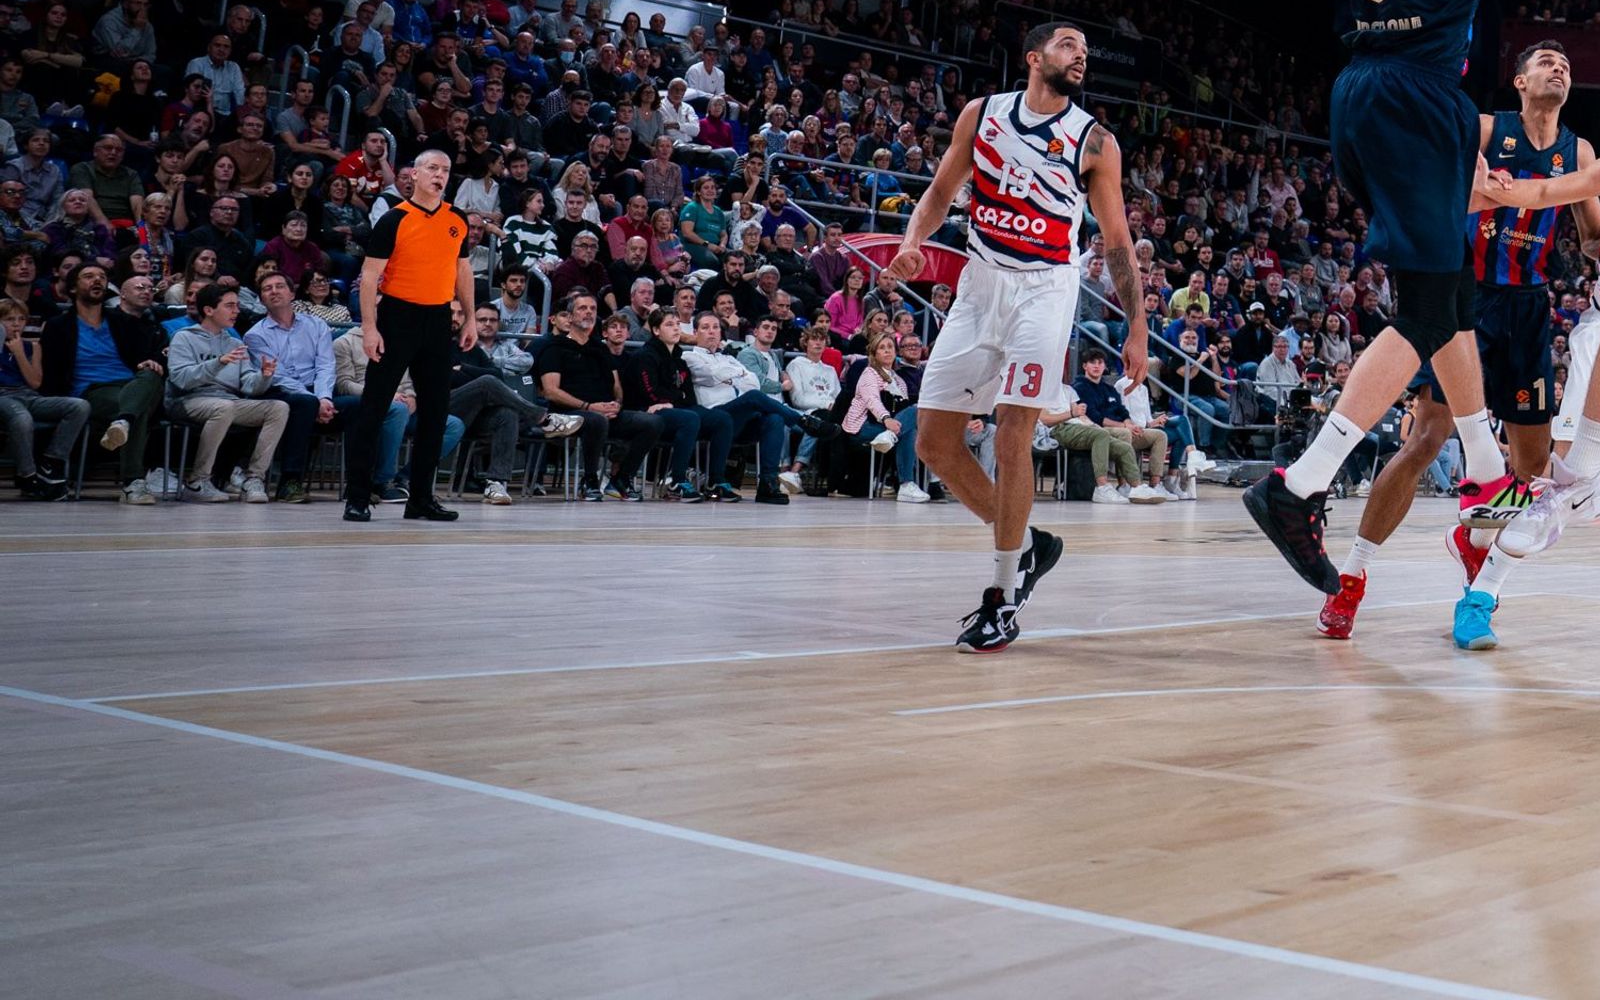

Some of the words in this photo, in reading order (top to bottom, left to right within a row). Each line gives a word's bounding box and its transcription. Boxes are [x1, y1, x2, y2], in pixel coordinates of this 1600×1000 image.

[997, 161, 1034, 200] 13
[975, 205, 1047, 235] CAZOO
[1004, 362, 1044, 398] 13
[1532, 377, 1546, 411] 1
